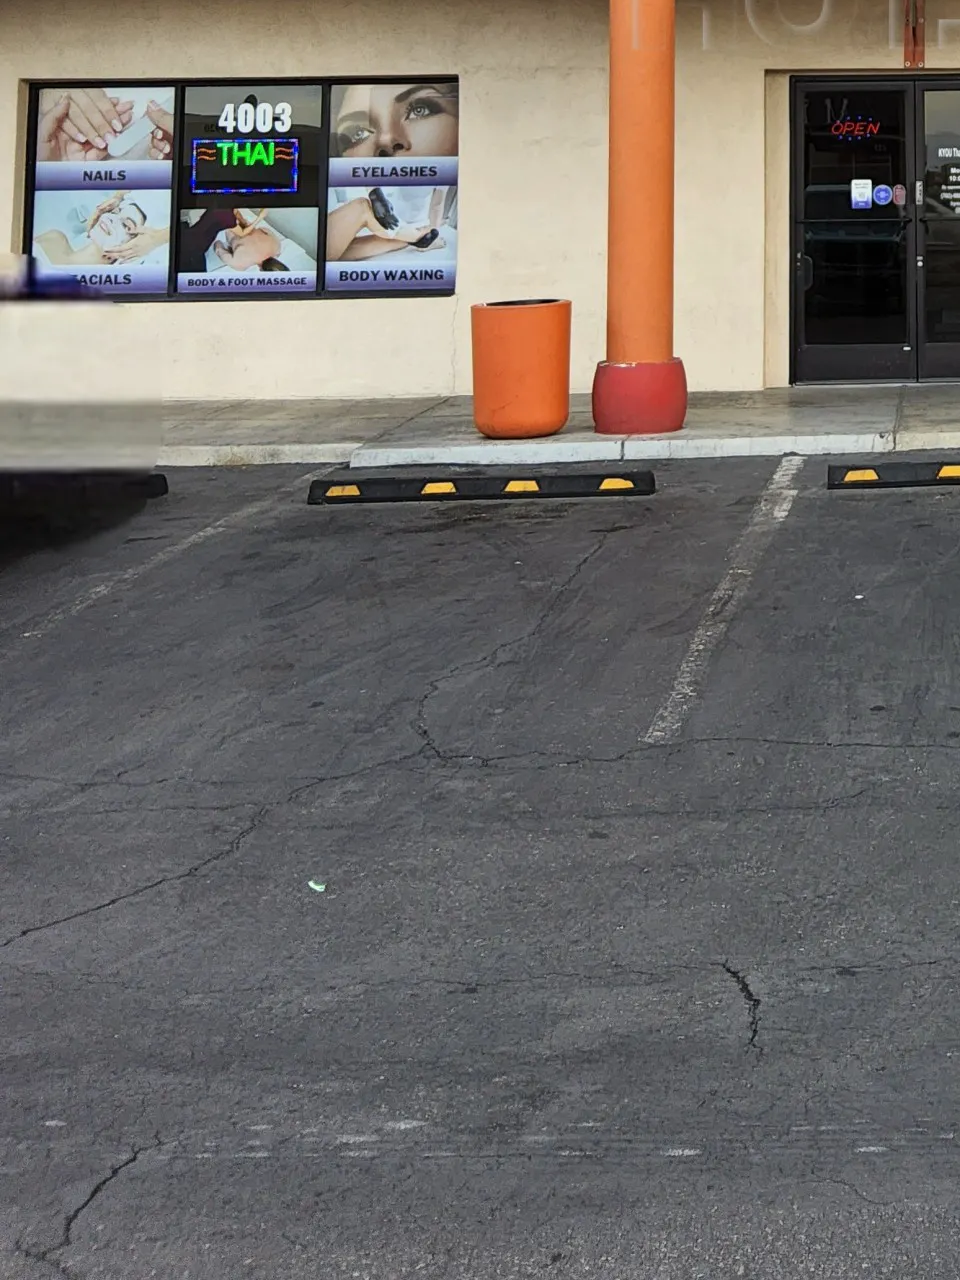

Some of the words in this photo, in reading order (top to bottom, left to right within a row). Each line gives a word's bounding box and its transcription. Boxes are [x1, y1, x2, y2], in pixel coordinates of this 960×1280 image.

[218, 102, 293, 133] 4003
[831, 120, 881, 136] OPEN
[217, 142, 275, 166] THAI
[82, 170, 127, 181] NAILS
[351, 166, 438, 179] EYELASHES
[69, 274, 132, 285] ACIALS
[187, 278, 216, 287] BODY
[218, 278, 226, 286] &
[227, 277, 255, 287] FOOT
[256, 277, 308, 287] MASSAGE
[339, 270, 380, 282] BODY
[384, 269, 444, 281] WAXING
